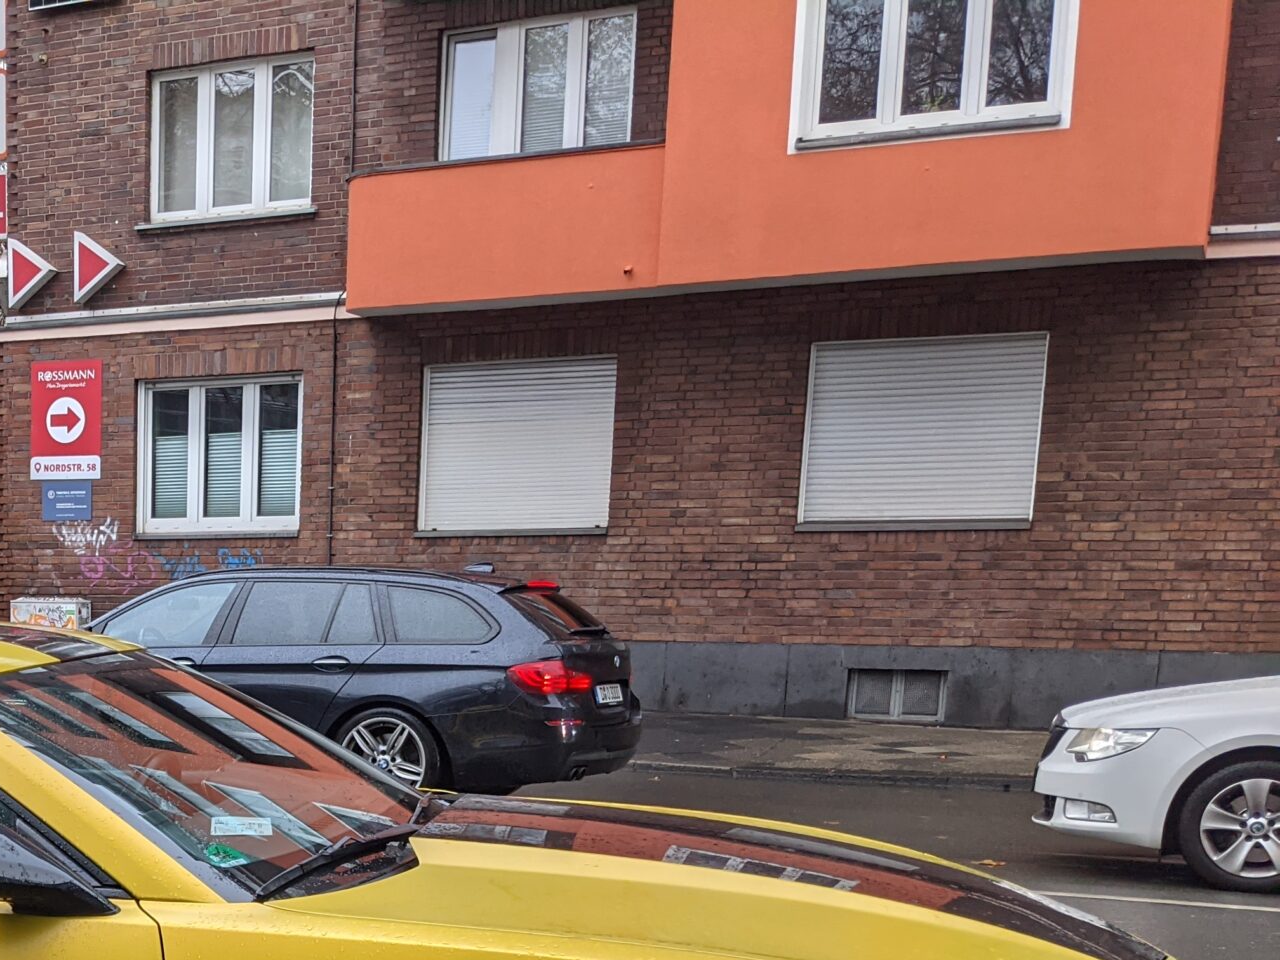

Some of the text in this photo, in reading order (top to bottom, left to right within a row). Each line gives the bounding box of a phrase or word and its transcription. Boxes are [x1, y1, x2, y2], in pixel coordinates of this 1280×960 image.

[37, 368, 95, 382] ROSSMANN
[43, 463, 97, 472] NORDSTR. 58
